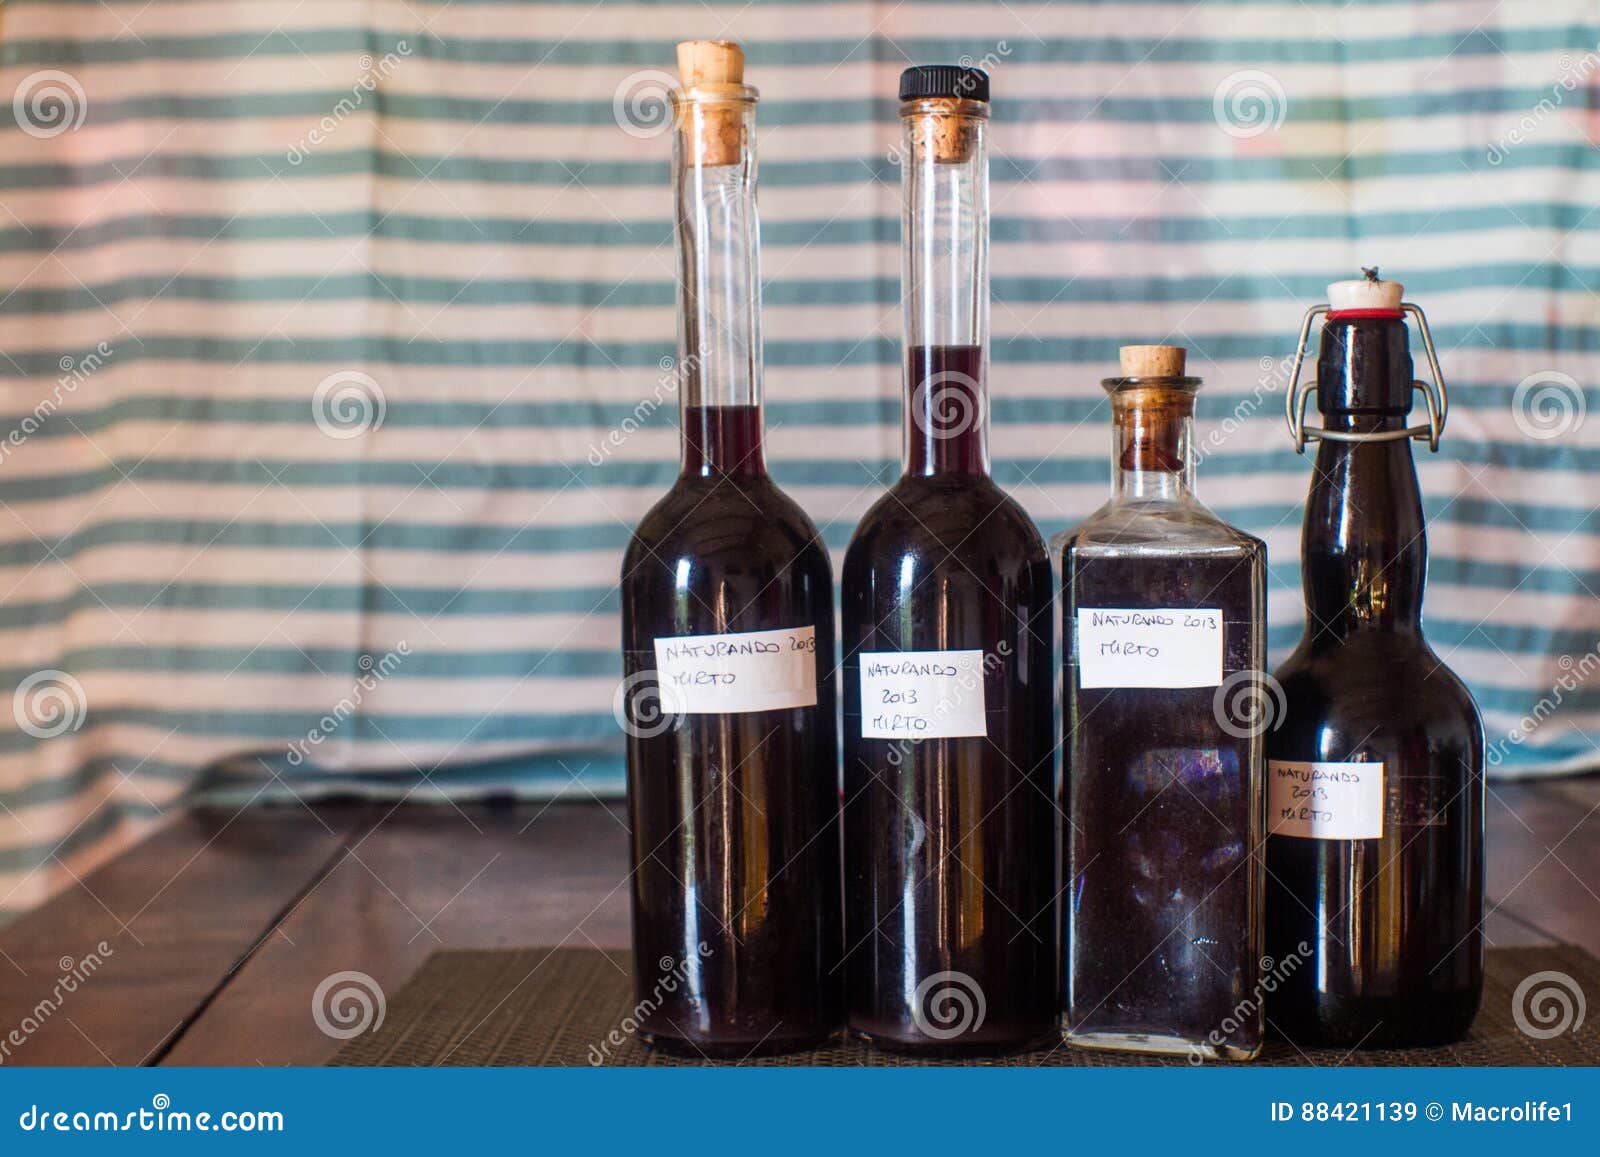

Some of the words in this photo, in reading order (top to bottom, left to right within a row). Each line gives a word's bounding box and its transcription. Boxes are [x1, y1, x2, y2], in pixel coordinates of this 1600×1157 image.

[1092, 612, 1174, 627] NATURANDO
[1184, 615, 1217, 629] 2013
[666, 641, 780, 661] NATURANDO
[788, 636, 816, 653] 2013
[1100, 639, 1160, 658] MIRTO
[867, 661, 957, 678] NATURANDO
[881, 689, 919, 704] 2013
[873, 714, 928, 731] MIRTO
[1277, 768, 1361, 783] NATURANDO
[1291, 785, 1329, 801] 2013
[1280, 807, 1333, 823] MIRTO
